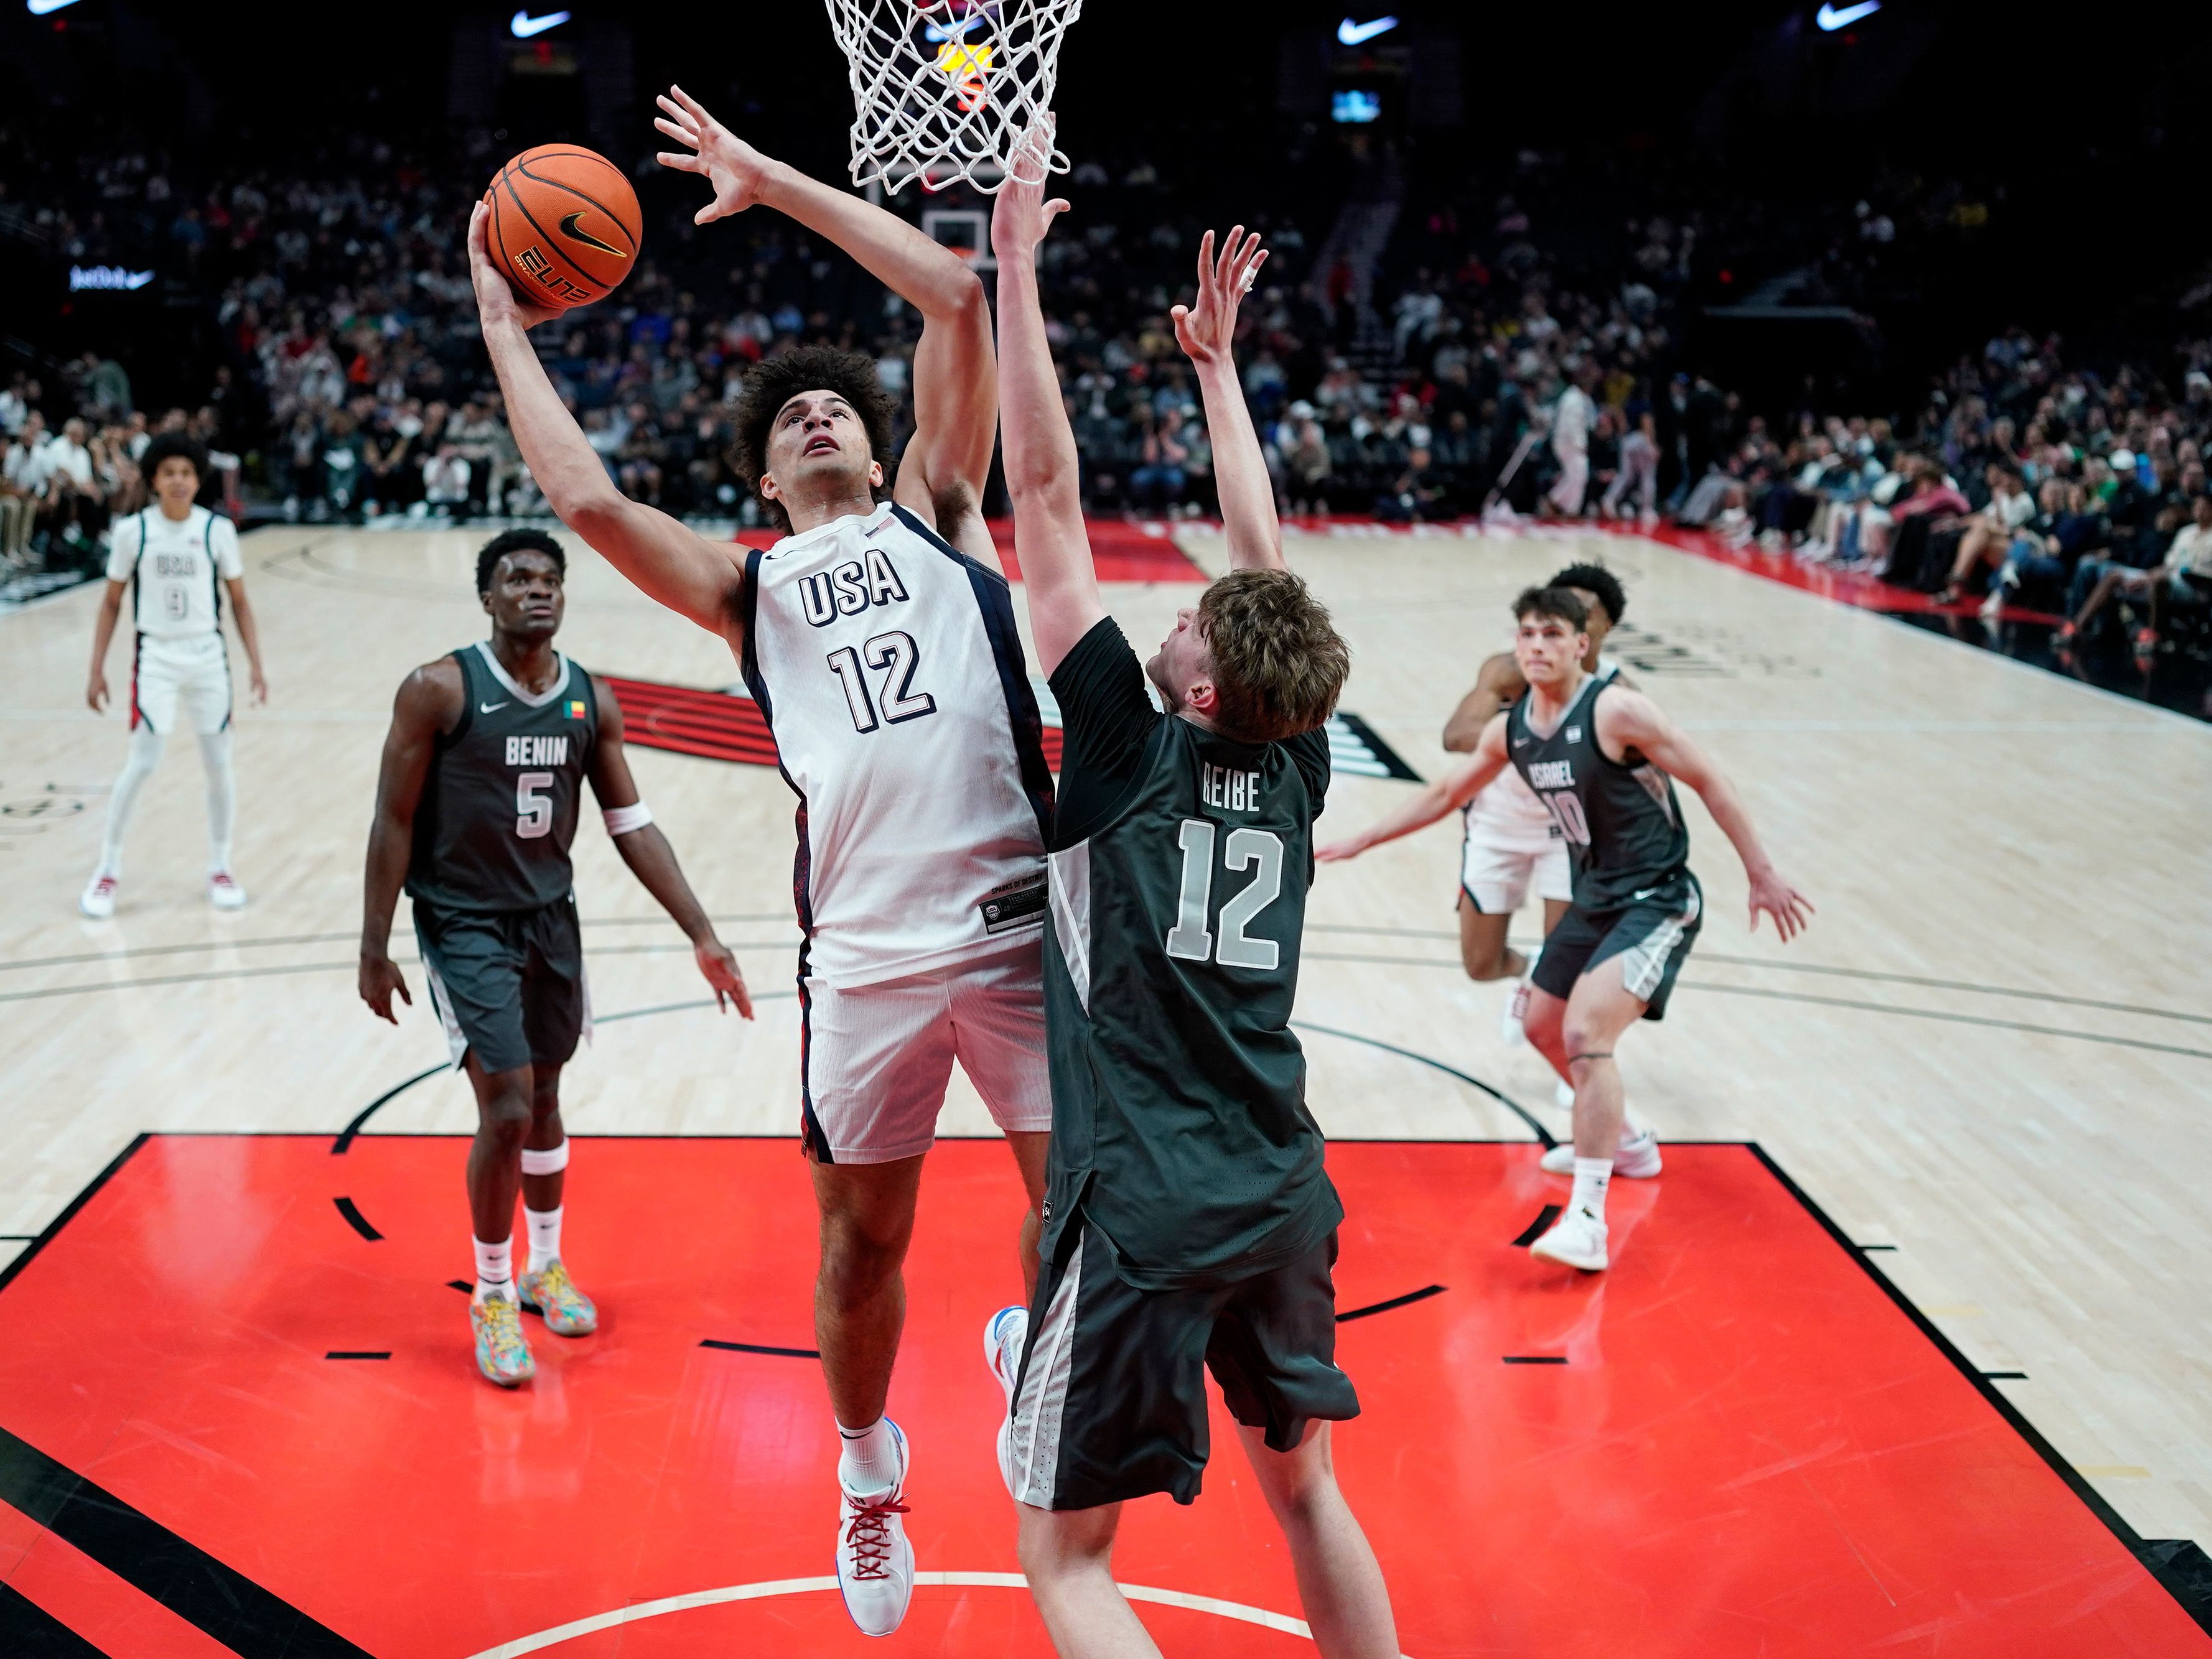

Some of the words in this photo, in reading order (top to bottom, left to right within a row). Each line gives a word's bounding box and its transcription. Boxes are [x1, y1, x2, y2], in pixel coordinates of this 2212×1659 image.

[519, 245, 592, 302] ELITE
[157, 555, 195, 576] USA
[798, 549, 910, 628] USA
[826, 630, 937, 734] 12
[505, 735, 568, 766] BENIN
[1527, 760, 1575, 789] ISRAEL
[515, 771, 554, 839] 5
[1202, 761, 1260, 812] REIBE
[1541, 790, 1591, 846] 10
[991, 883, 1013, 895] SPARKS
[1165, 819, 1284, 970] 12
